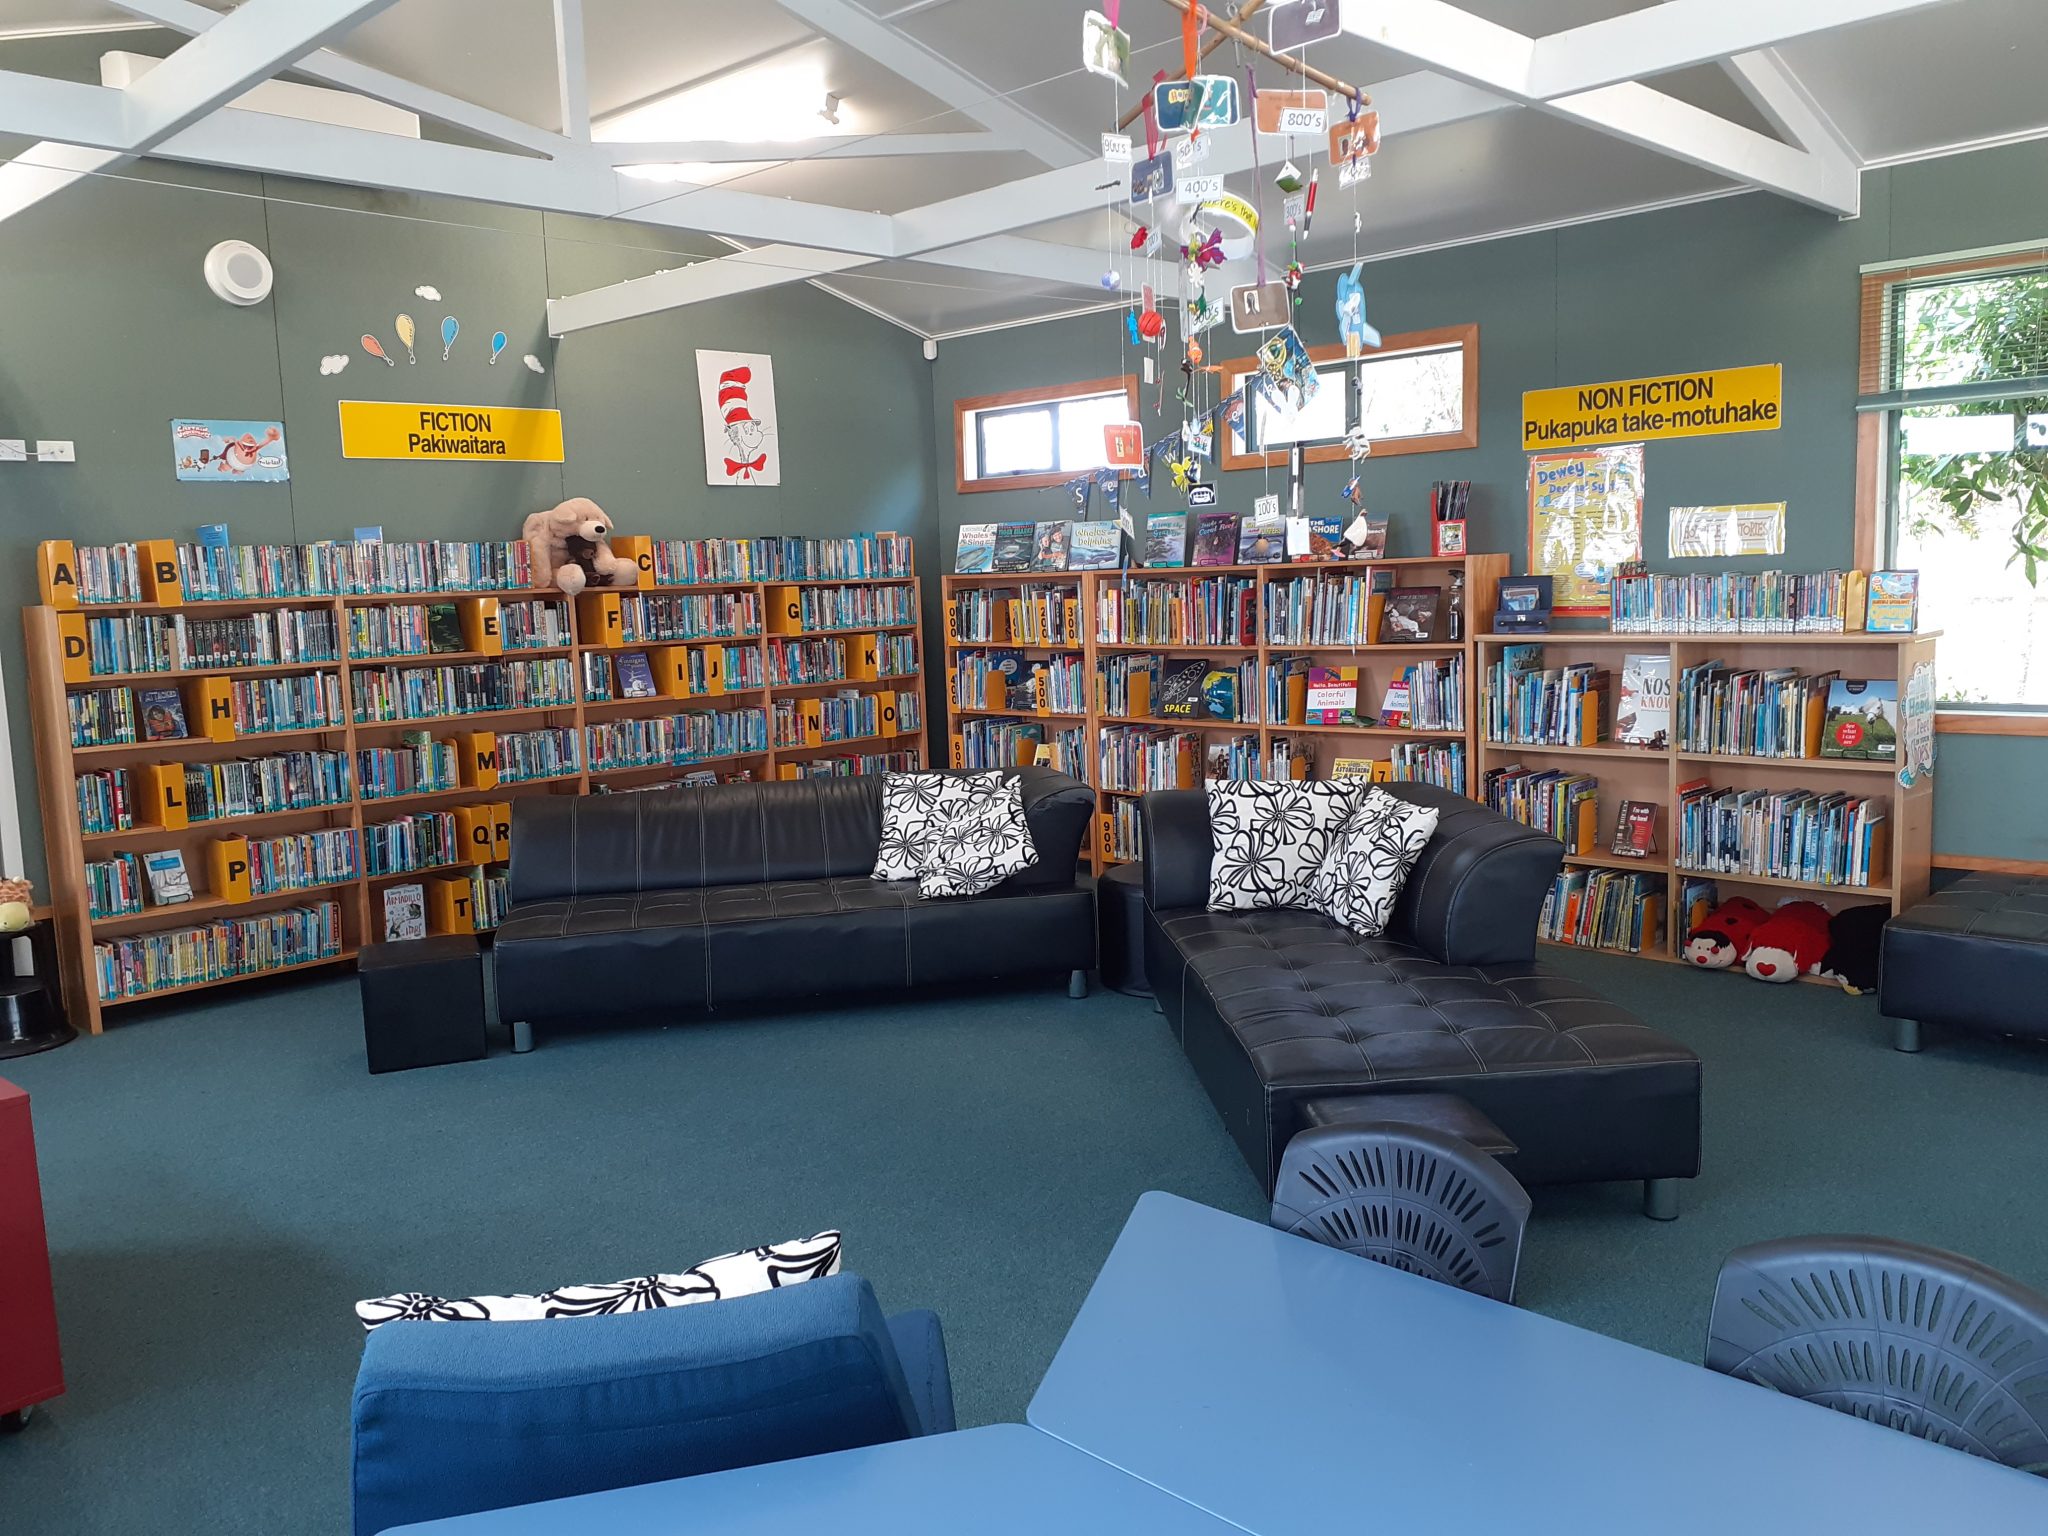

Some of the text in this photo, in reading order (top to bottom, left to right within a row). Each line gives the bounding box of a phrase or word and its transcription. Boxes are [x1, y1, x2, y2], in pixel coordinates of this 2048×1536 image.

[1288, 112, 1321, 127] 800's
[1104, 138, 1126, 153] 900s
[1184, 179, 1218, 194] 400's
[1578, 376, 1714, 412] NON FICTION
[420, 411, 492, 433] FICTION
[1524, 399, 1778, 443] Pukapuka take-motuhake
[408, 433, 506, 455] Pakiwaitara
[1537, 461, 1585, 485] Dewey
[1259, 501, 1276, 516] 100's
[1075, 526, 1106, 538] Whales
[968, 539, 985, 547] Sing
[637, 553, 651, 572] C
[53, 563, 75, 585] A
[155, 562, 177, 583] B
[608, 610, 619, 629] F
[788, 603, 799, 619] G
[484, 616, 498, 636] E
[1067, 607, 1075, 639] 300
[64, 636, 85, 658] D
[865, 649, 876, 666] K
[677, 663, 684, 681] I
[711, 661, 718, 679] J
[1129, 664, 1150, 673] SIMPLE
[1038, 677, 1046, 708] 500
[1317, 690, 1346, 698] Colorful
[211, 698, 231, 719] H
[1163, 704, 1192, 714] SPACE
[1317, 699, 1345, 707] Animals
[808, 714, 819, 731] N
[883, 706, 895, 721] O
[477, 751, 496, 771] M
[166, 786, 182, 808] L
[473, 822, 510, 845] Q R
[1103, 821, 1112, 853] 900
[229, 860, 246, 882] P
[386, 893, 421, 906] ARMADILLO
[455, 898, 469, 917] T
